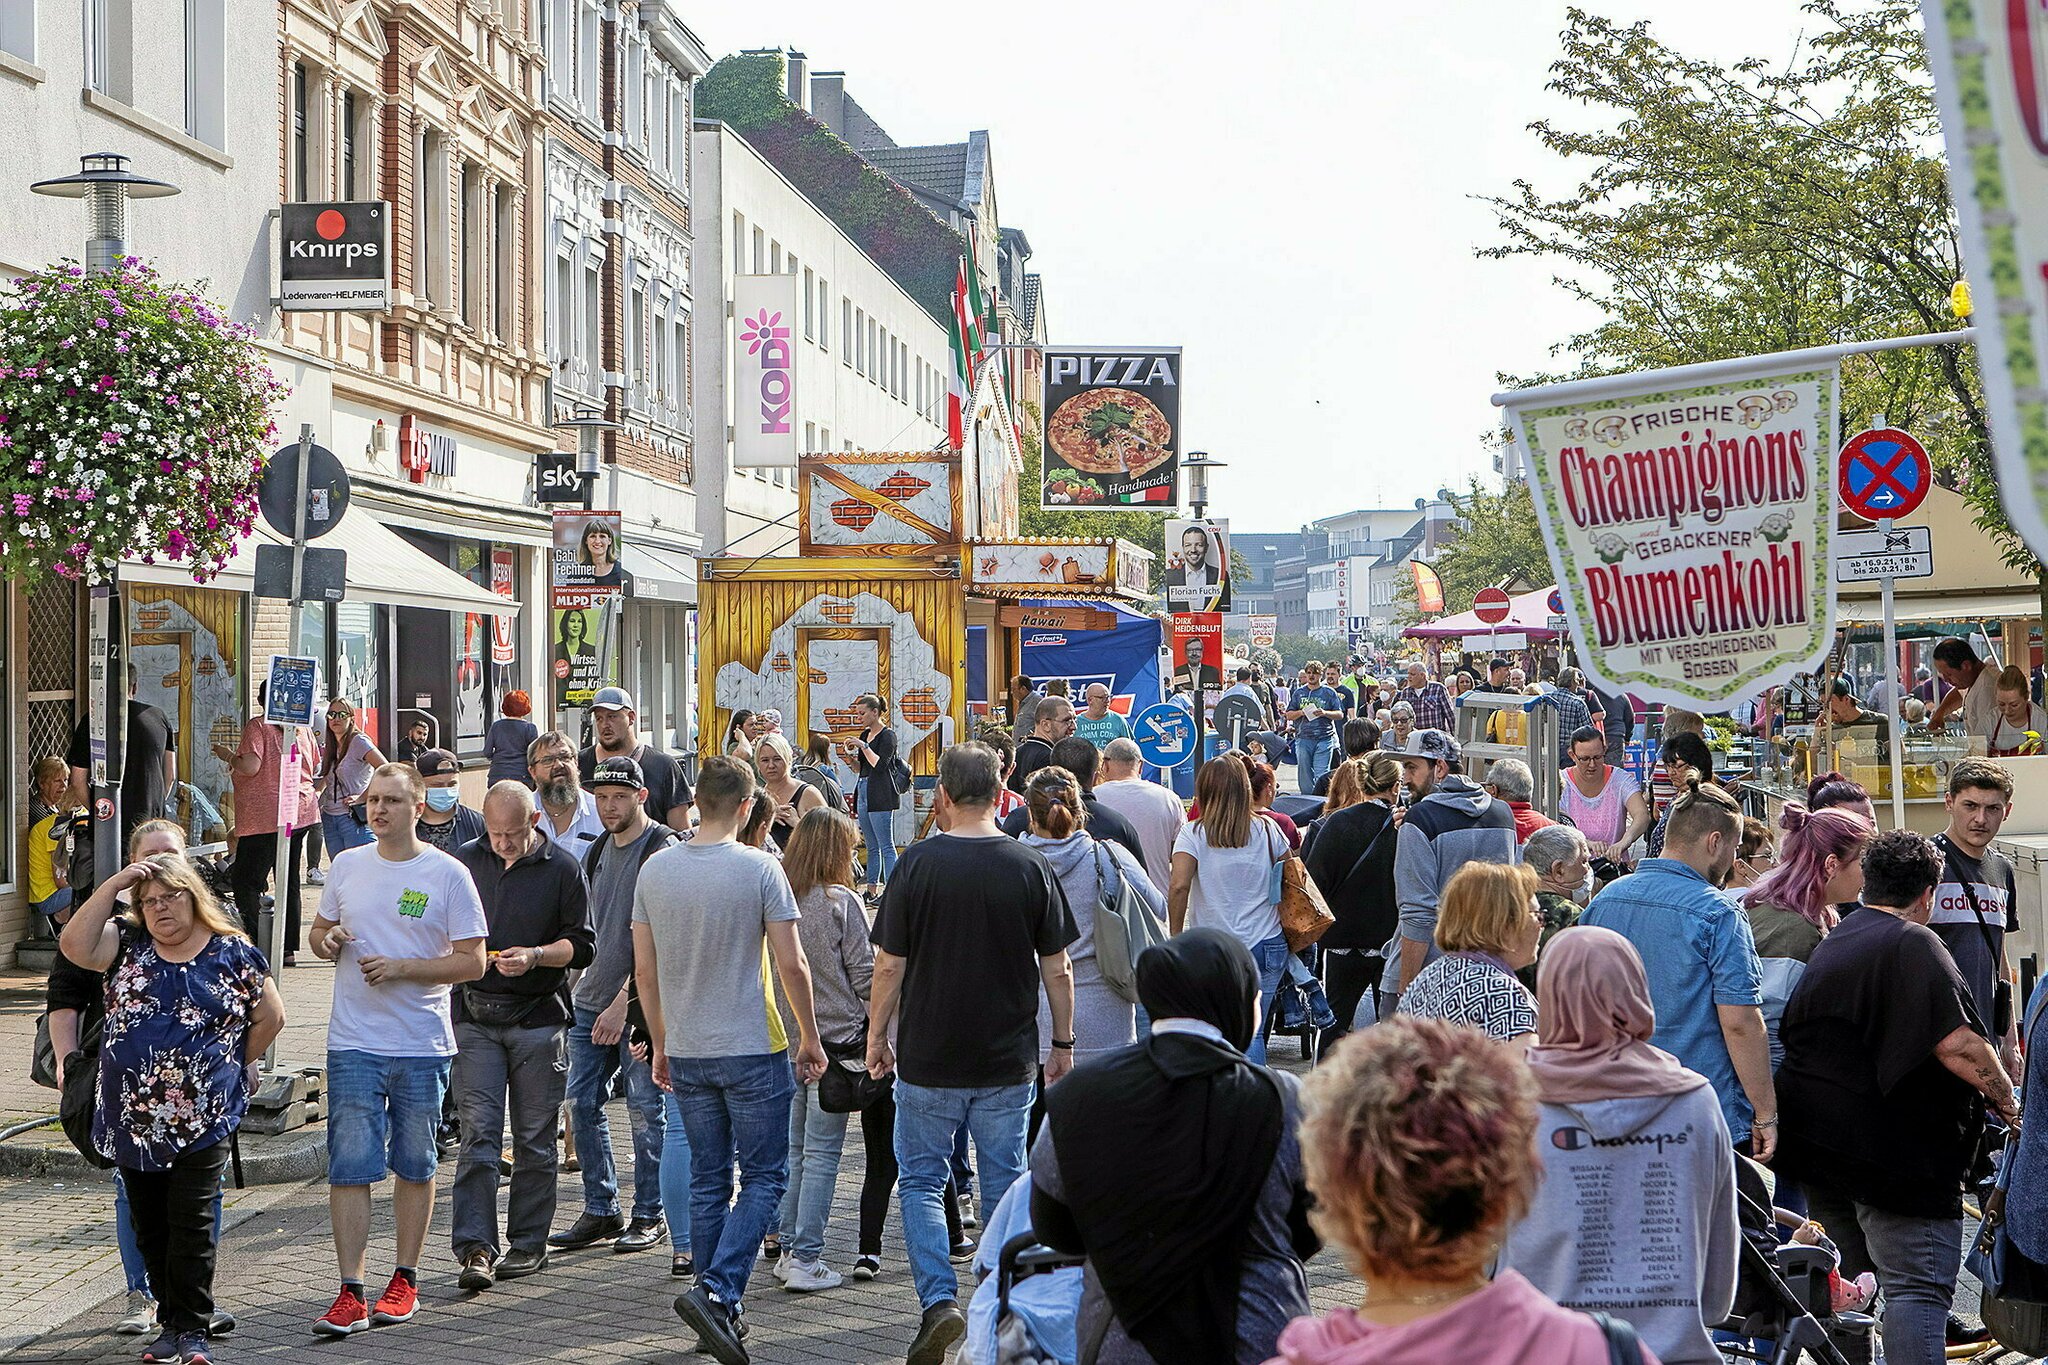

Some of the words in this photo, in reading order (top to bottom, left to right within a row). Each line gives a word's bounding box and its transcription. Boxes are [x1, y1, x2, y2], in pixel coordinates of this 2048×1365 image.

[289, 240, 379, 268] Knirps
[283, 290, 385, 300] Lederwaren-HELFMEIER
[1050, 356, 1177, 386] PIZZA
[761, 327, 790, 434] KODI
[1631, 405, 1734, 435] FRISCHE
[542, 464, 582, 492] sky
[1108, 472, 1174, 496] Handmade!
[1559, 427, 1806, 529] Champignons
[1635, 531, 1751, 561] GEBACKENER
[555, 549, 576, 562] Gabi
[1863, 559, 1897, 567] 16.9.21,
[555, 562, 596, 576] Fechtner
[1868, 566, 1902, 574] 20.9.21,
[1170, 587, 1198, 596] Florian
[1199, 586, 1221, 595] Fuchs
[1584, 540, 1806, 648] Blumenkohl
[556, 595, 590, 606] MLPD
[1020, 614, 1066, 627] Hawaii
[1174, 624, 1221, 633] HEIDENBLUT
[1175, 617, 1192, 625] DIRK
[1639, 646, 1662, 666] MIT
[1665, 633, 1777, 661] VERSCHIEDENEN
[573, 666, 587, 677] und
[1683, 657, 1739, 680] SOSSEN
[1081, 721, 1113, 731] INDIGO
[1940, 893, 1999, 913] adias
